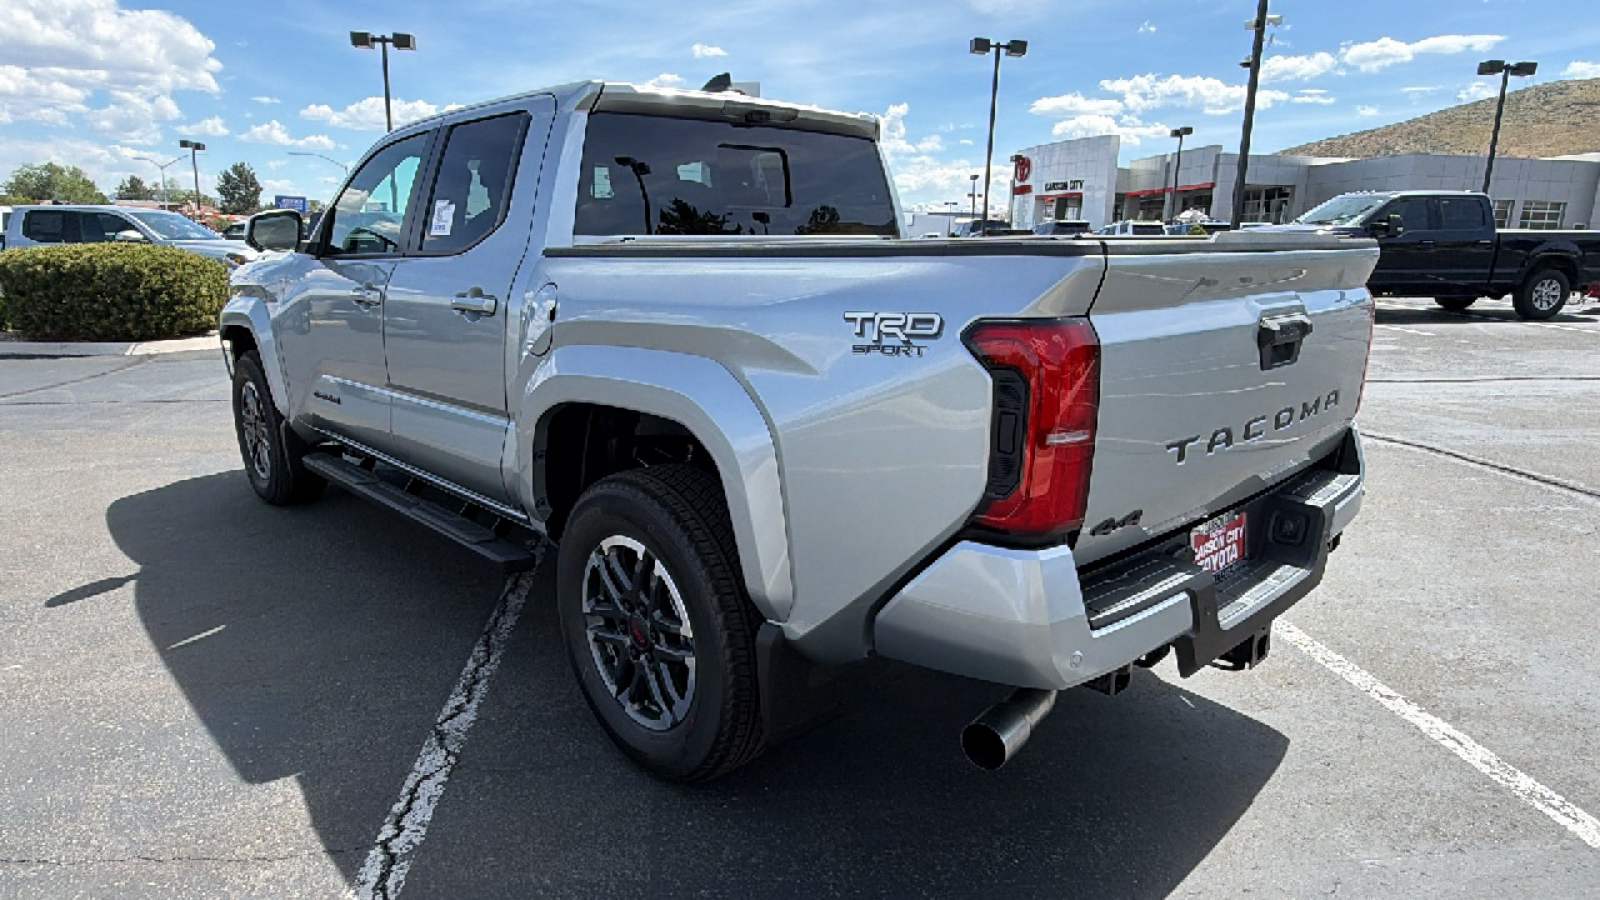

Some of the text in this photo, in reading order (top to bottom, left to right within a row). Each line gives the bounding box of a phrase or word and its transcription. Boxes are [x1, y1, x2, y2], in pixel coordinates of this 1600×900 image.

[1045, 180, 1084, 191] CARSON CITY
[843, 311, 945, 345] TRD
[851, 344, 929, 357] SPORT
[1165, 389, 1340, 466] TACOMA
[1225, 524, 1245, 544] CITY
